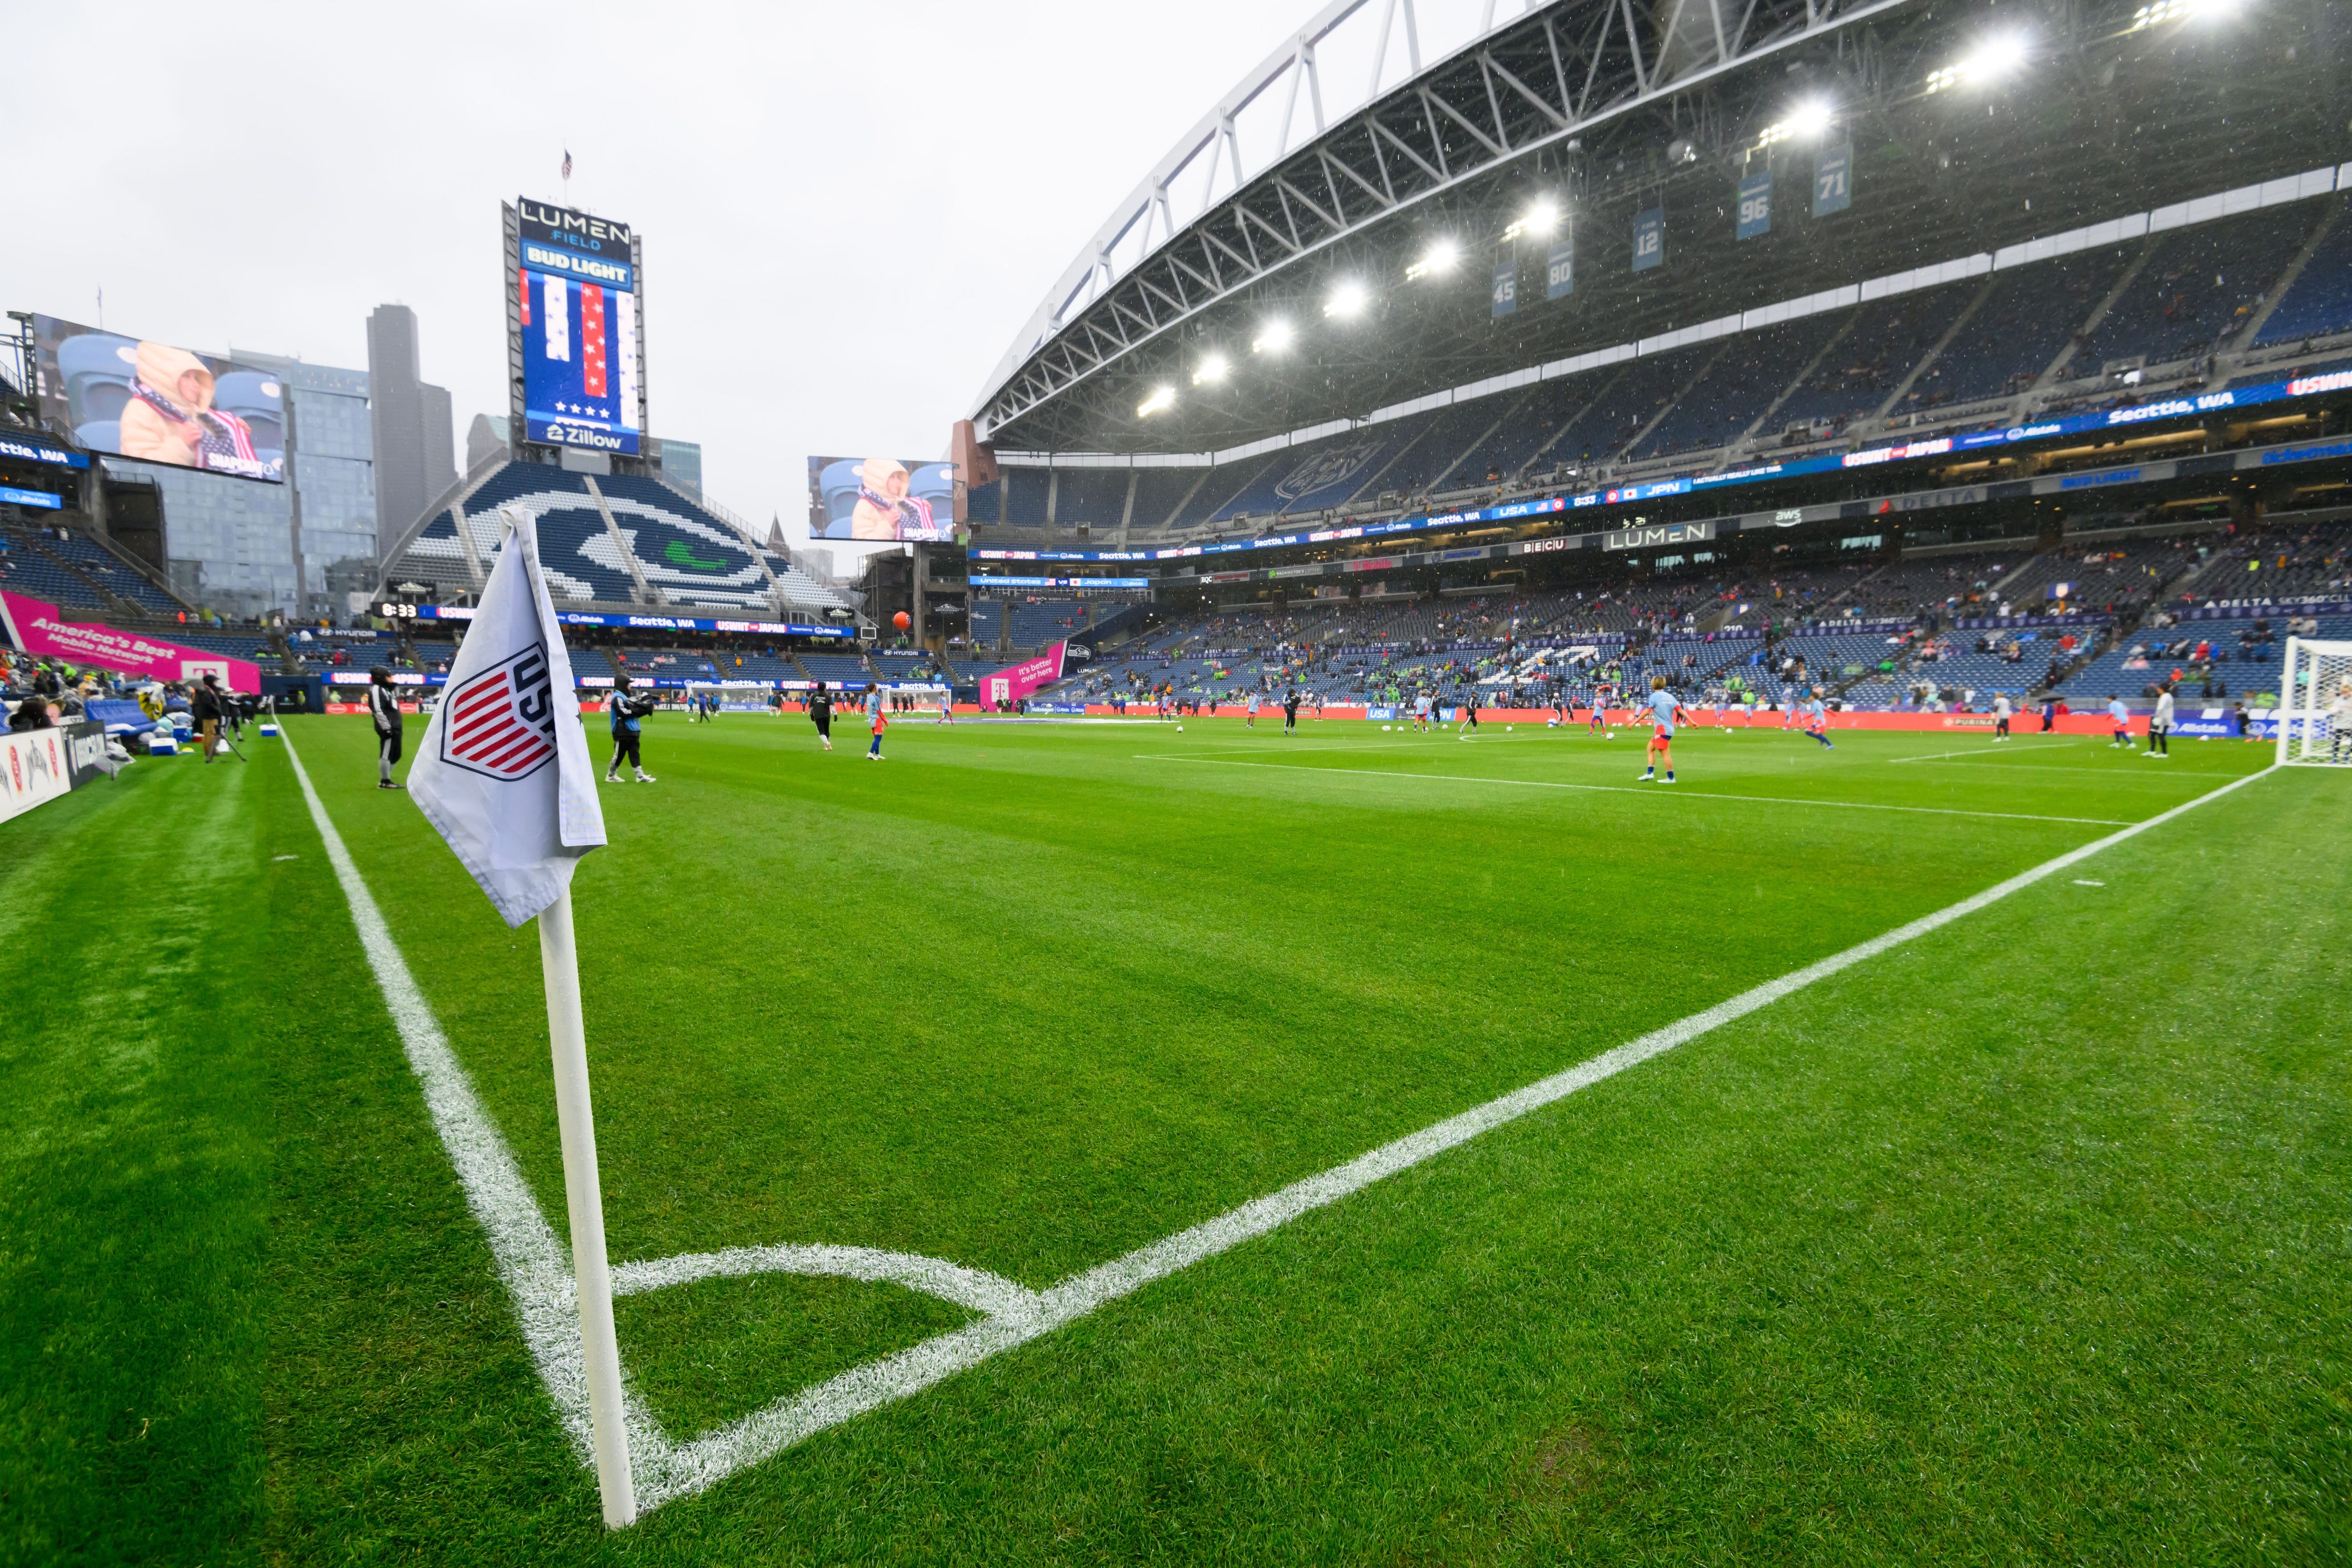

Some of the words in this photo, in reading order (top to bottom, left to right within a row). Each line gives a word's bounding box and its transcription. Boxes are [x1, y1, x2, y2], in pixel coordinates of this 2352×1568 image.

[1819, 172, 1845, 200] 71
[1741, 195, 1768, 224] 96
[520, 201, 630, 244] LUMEN
[552, 230, 601, 251] FIELD
[1637, 231, 1659, 256] 12
[527, 246, 570, 270] BUD
[571, 257, 627, 283] LIGHT
[1550, 262, 1571, 286] 80
[1494, 281, 1514, 304] 45
[2109, 401, 2195, 423] Seattle,
[2198, 392, 2234, 410] WA
[566, 427, 621, 450] Zillow
[39, 449, 68, 463] WA
[1845, 448, 1892, 467] USWNT
[1905, 438, 1949, 458] JAPAN
[1647, 483, 1680, 495] JPN
[1574, 496, 1596, 506] 8:33
[1902, 491, 1975, 510] DELTA
[1500, 505, 1528, 516] USA
[1776, 509, 1801, 521] aws
[1427, 514, 1463, 526] Seattle,
[1465, 512, 1480, 520] WA
[1310, 531, 1334, 541] USWNT
[1341, 528, 1362, 538] JAPAN
[1611, 524, 1705, 548] LUMEN
[1255, 537, 1283, 547] Seattle,
[1158, 549, 1177, 558] USWNT
[1183, 547, 1200, 556] JAPAN
[1362, 559, 1393, 570] Mobile
[2220, 597, 2272, 608] DELTA
[382, 603, 416, 617] 8:33
[440, 607, 476, 619] USWN
[629, 616, 676, 627] Seattle,
[677, 619, 696, 627] WA
[718, 621, 749, 631] USWNT
[758, 623, 785, 633] JAPAN
[31, 618, 132, 648] America's
[132, 640, 176, 659] Best
[48, 633, 95, 650] Mobile
[96, 644, 155, 664] Network
[1019, 666, 1030, 676] It's
[1031, 659, 1052, 671] better
[334, 673, 371, 684] USWN
[393, 673, 424, 684] APAN
[1022, 673, 1036, 683] over
[1037, 667, 1053, 677] here
[631, 678, 654, 687] PAN
[995, 683, 1004, 697] T
[1370, 709, 1390, 718] USA
[2178, 722, 2228, 733] Allstate
